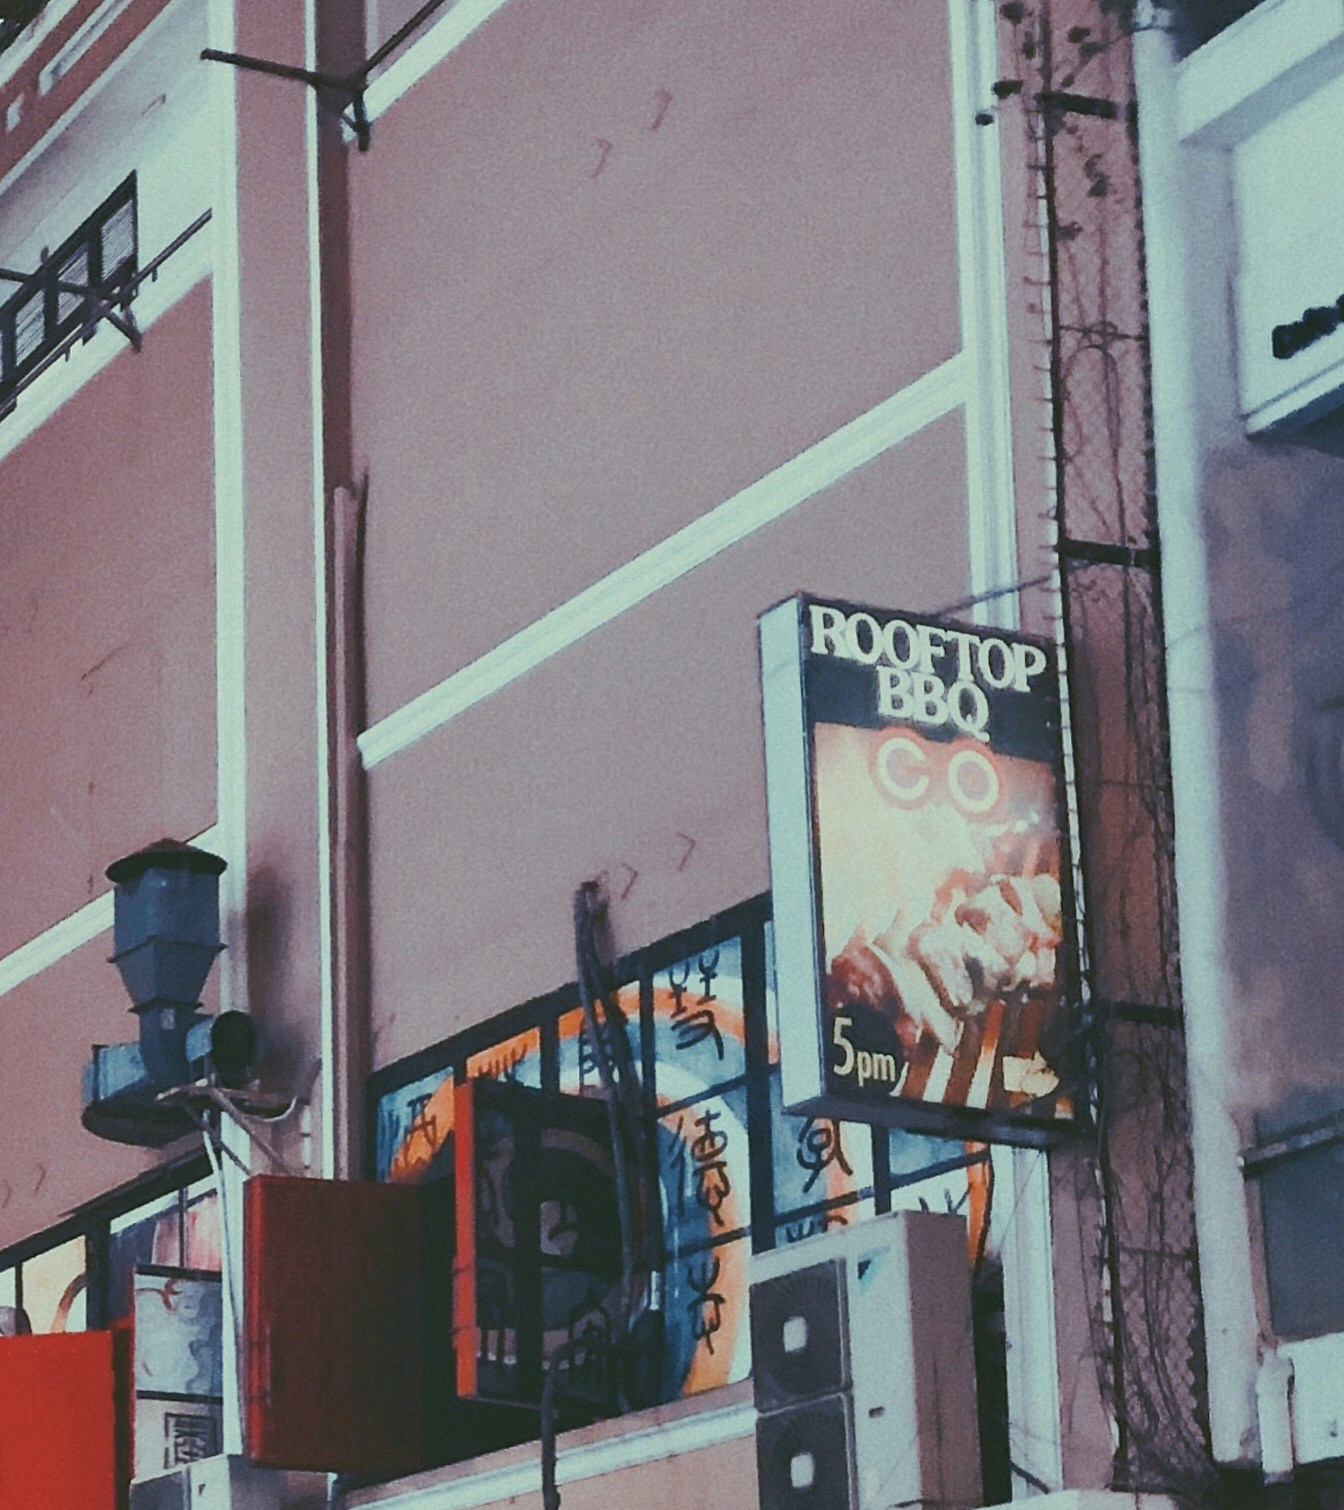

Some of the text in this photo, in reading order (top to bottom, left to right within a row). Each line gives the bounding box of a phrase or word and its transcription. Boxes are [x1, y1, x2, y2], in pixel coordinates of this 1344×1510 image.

[809, 605, 1047, 692] ROOFTOP
[876, 665, 990, 742] BBQ
[833, 1017, 895, 1086] 5pm
